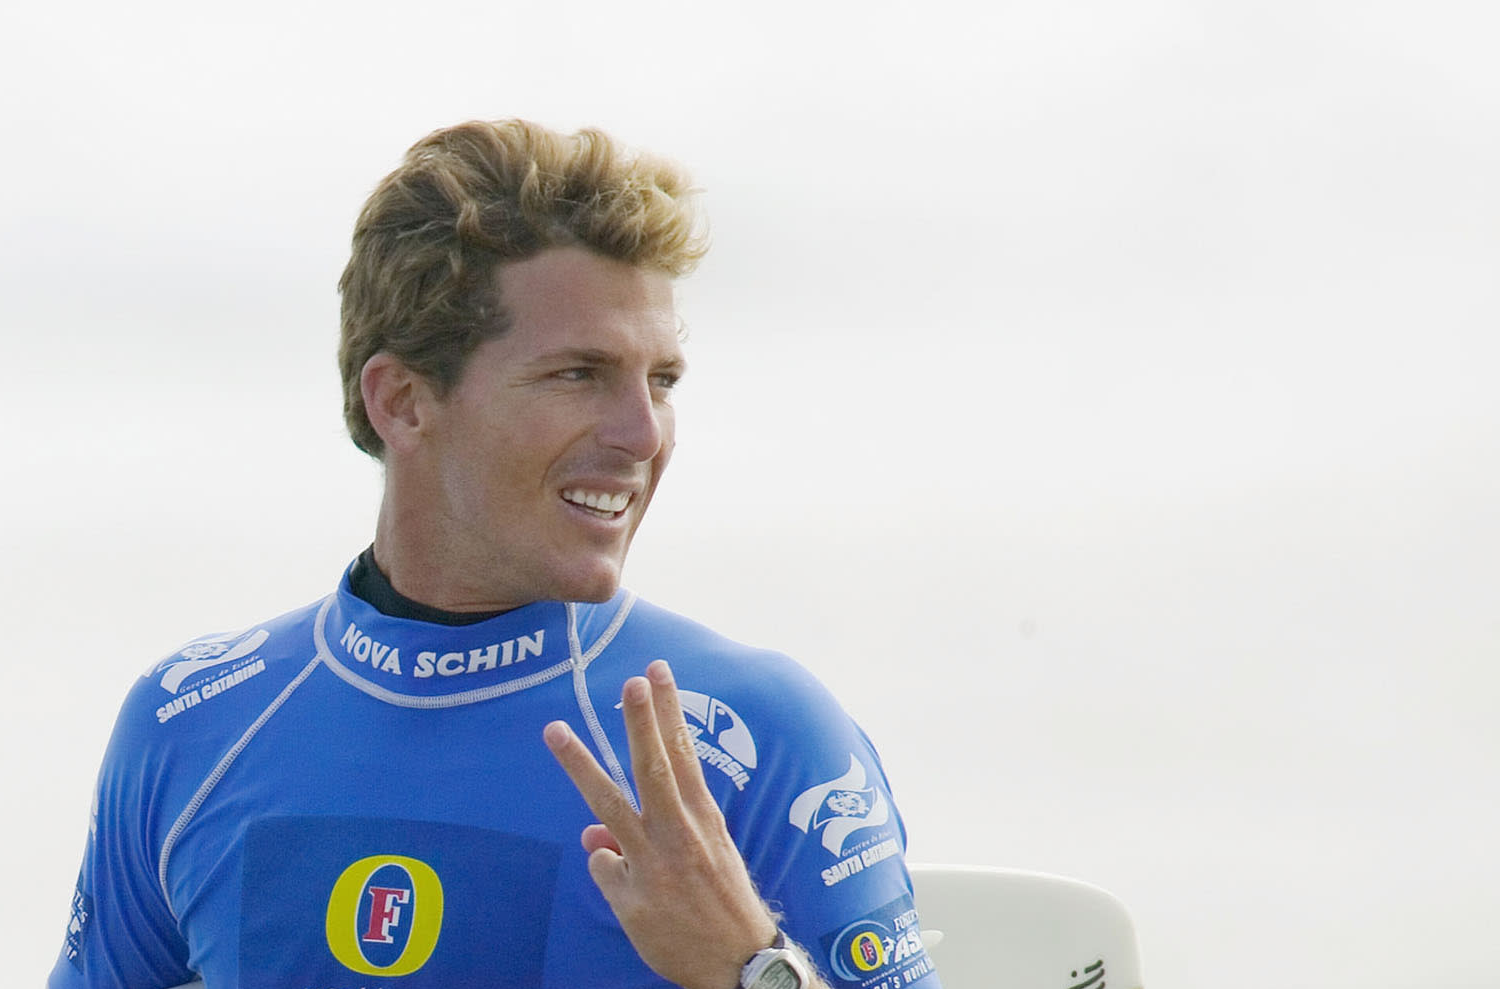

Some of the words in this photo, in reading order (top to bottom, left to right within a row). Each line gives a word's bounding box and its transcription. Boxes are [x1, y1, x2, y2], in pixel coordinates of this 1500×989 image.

[340, 622, 402, 675] NOVA
[414, 629, 545, 678] SCHIN
[156, 690, 202, 723] SANTA
[202, 659, 266, 700] CATARINA
[821, 855, 863, 886] SANTA
